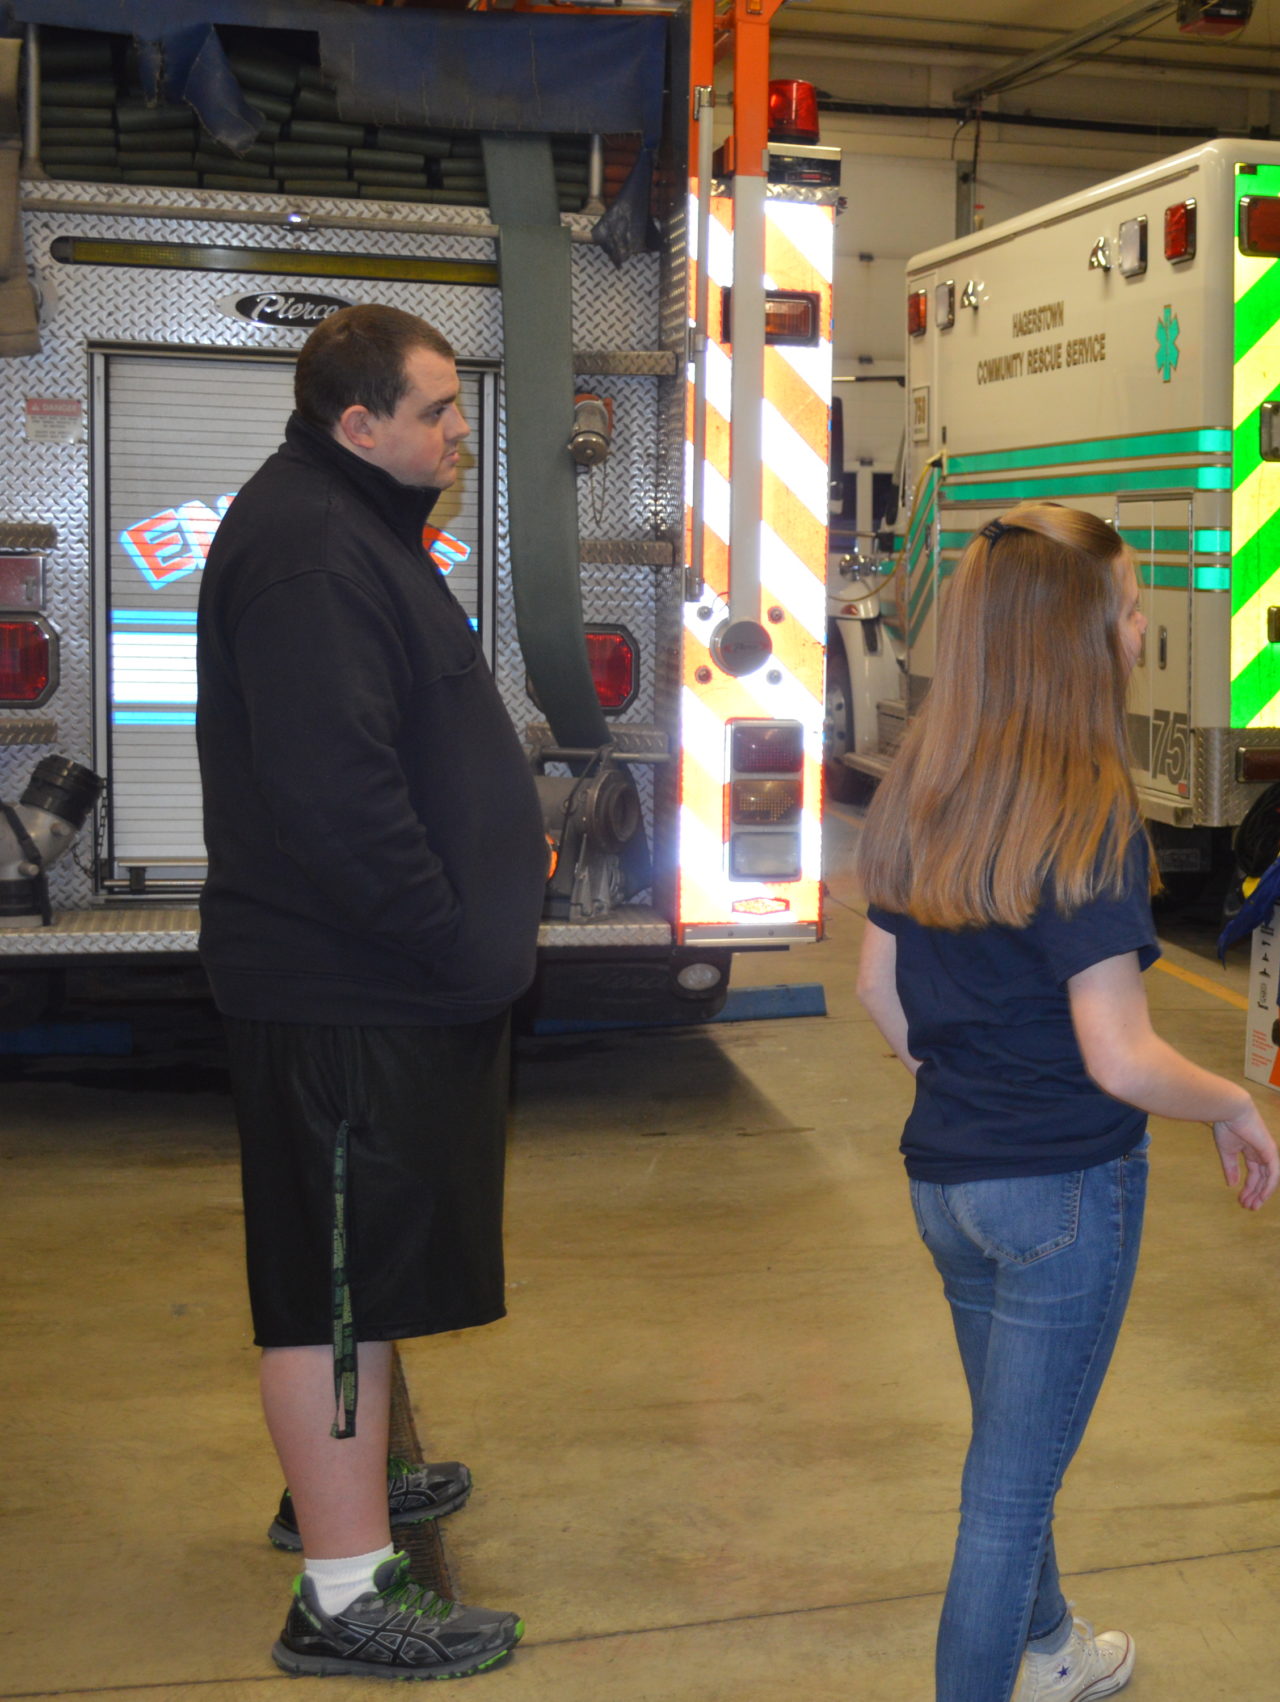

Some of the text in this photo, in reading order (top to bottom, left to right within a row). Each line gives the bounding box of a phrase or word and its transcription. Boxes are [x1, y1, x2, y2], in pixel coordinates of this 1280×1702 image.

[1012, 301, 1064, 338] HAGERSTOWN
[977, 333, 1105, 385] COMMUNITY RESCUE SERVICE
